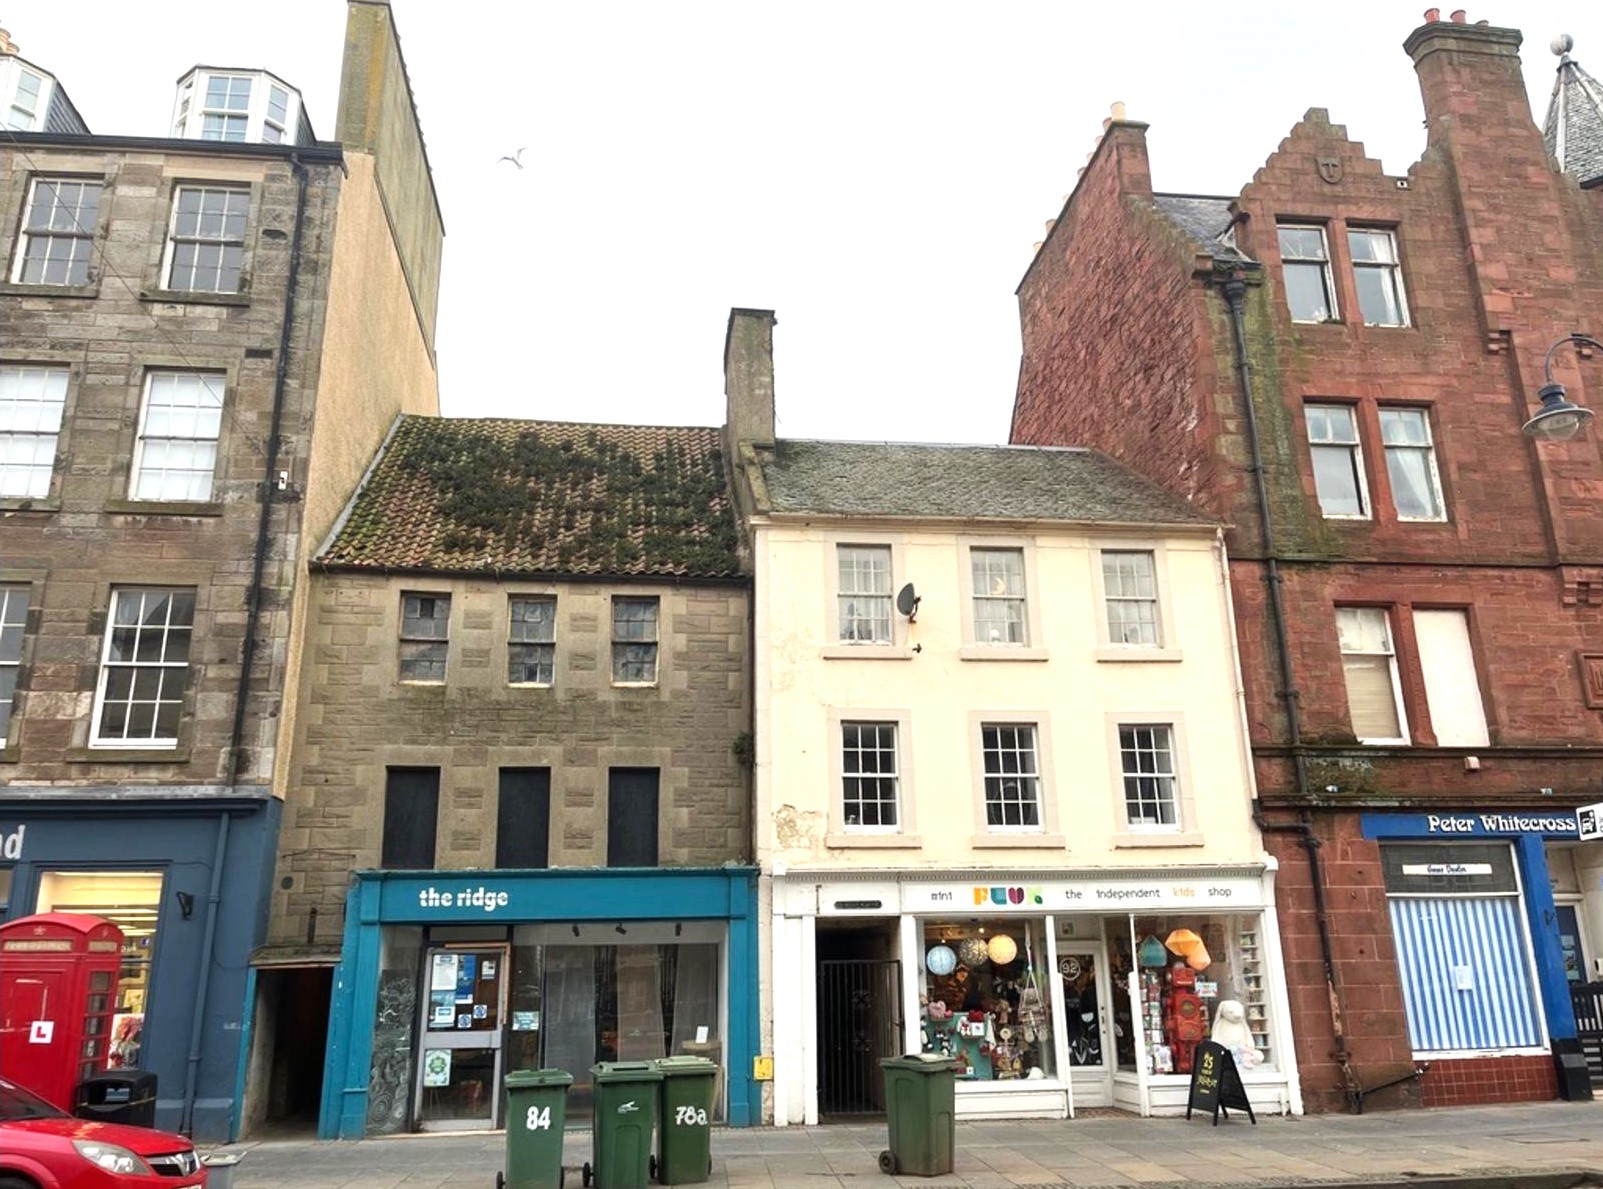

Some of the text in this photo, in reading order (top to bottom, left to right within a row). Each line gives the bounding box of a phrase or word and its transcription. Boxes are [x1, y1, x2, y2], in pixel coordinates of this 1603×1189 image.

[1428, 815, 1577, 832] Peter Whitecross
[0, 824, 26, 859] d
[419, 887, 508, 912] the ridge
[1065, 889, 1083, 899] the
[1096, 889, 1161, 900] independent
[1173, 887, 1195, 897] kids
[1208, 887, 1232, 897] shop
[1062, 962, 1078, 974] 92
[36, 1026, 46, 1038] L
[526, 1106, 551, 1130] 84
